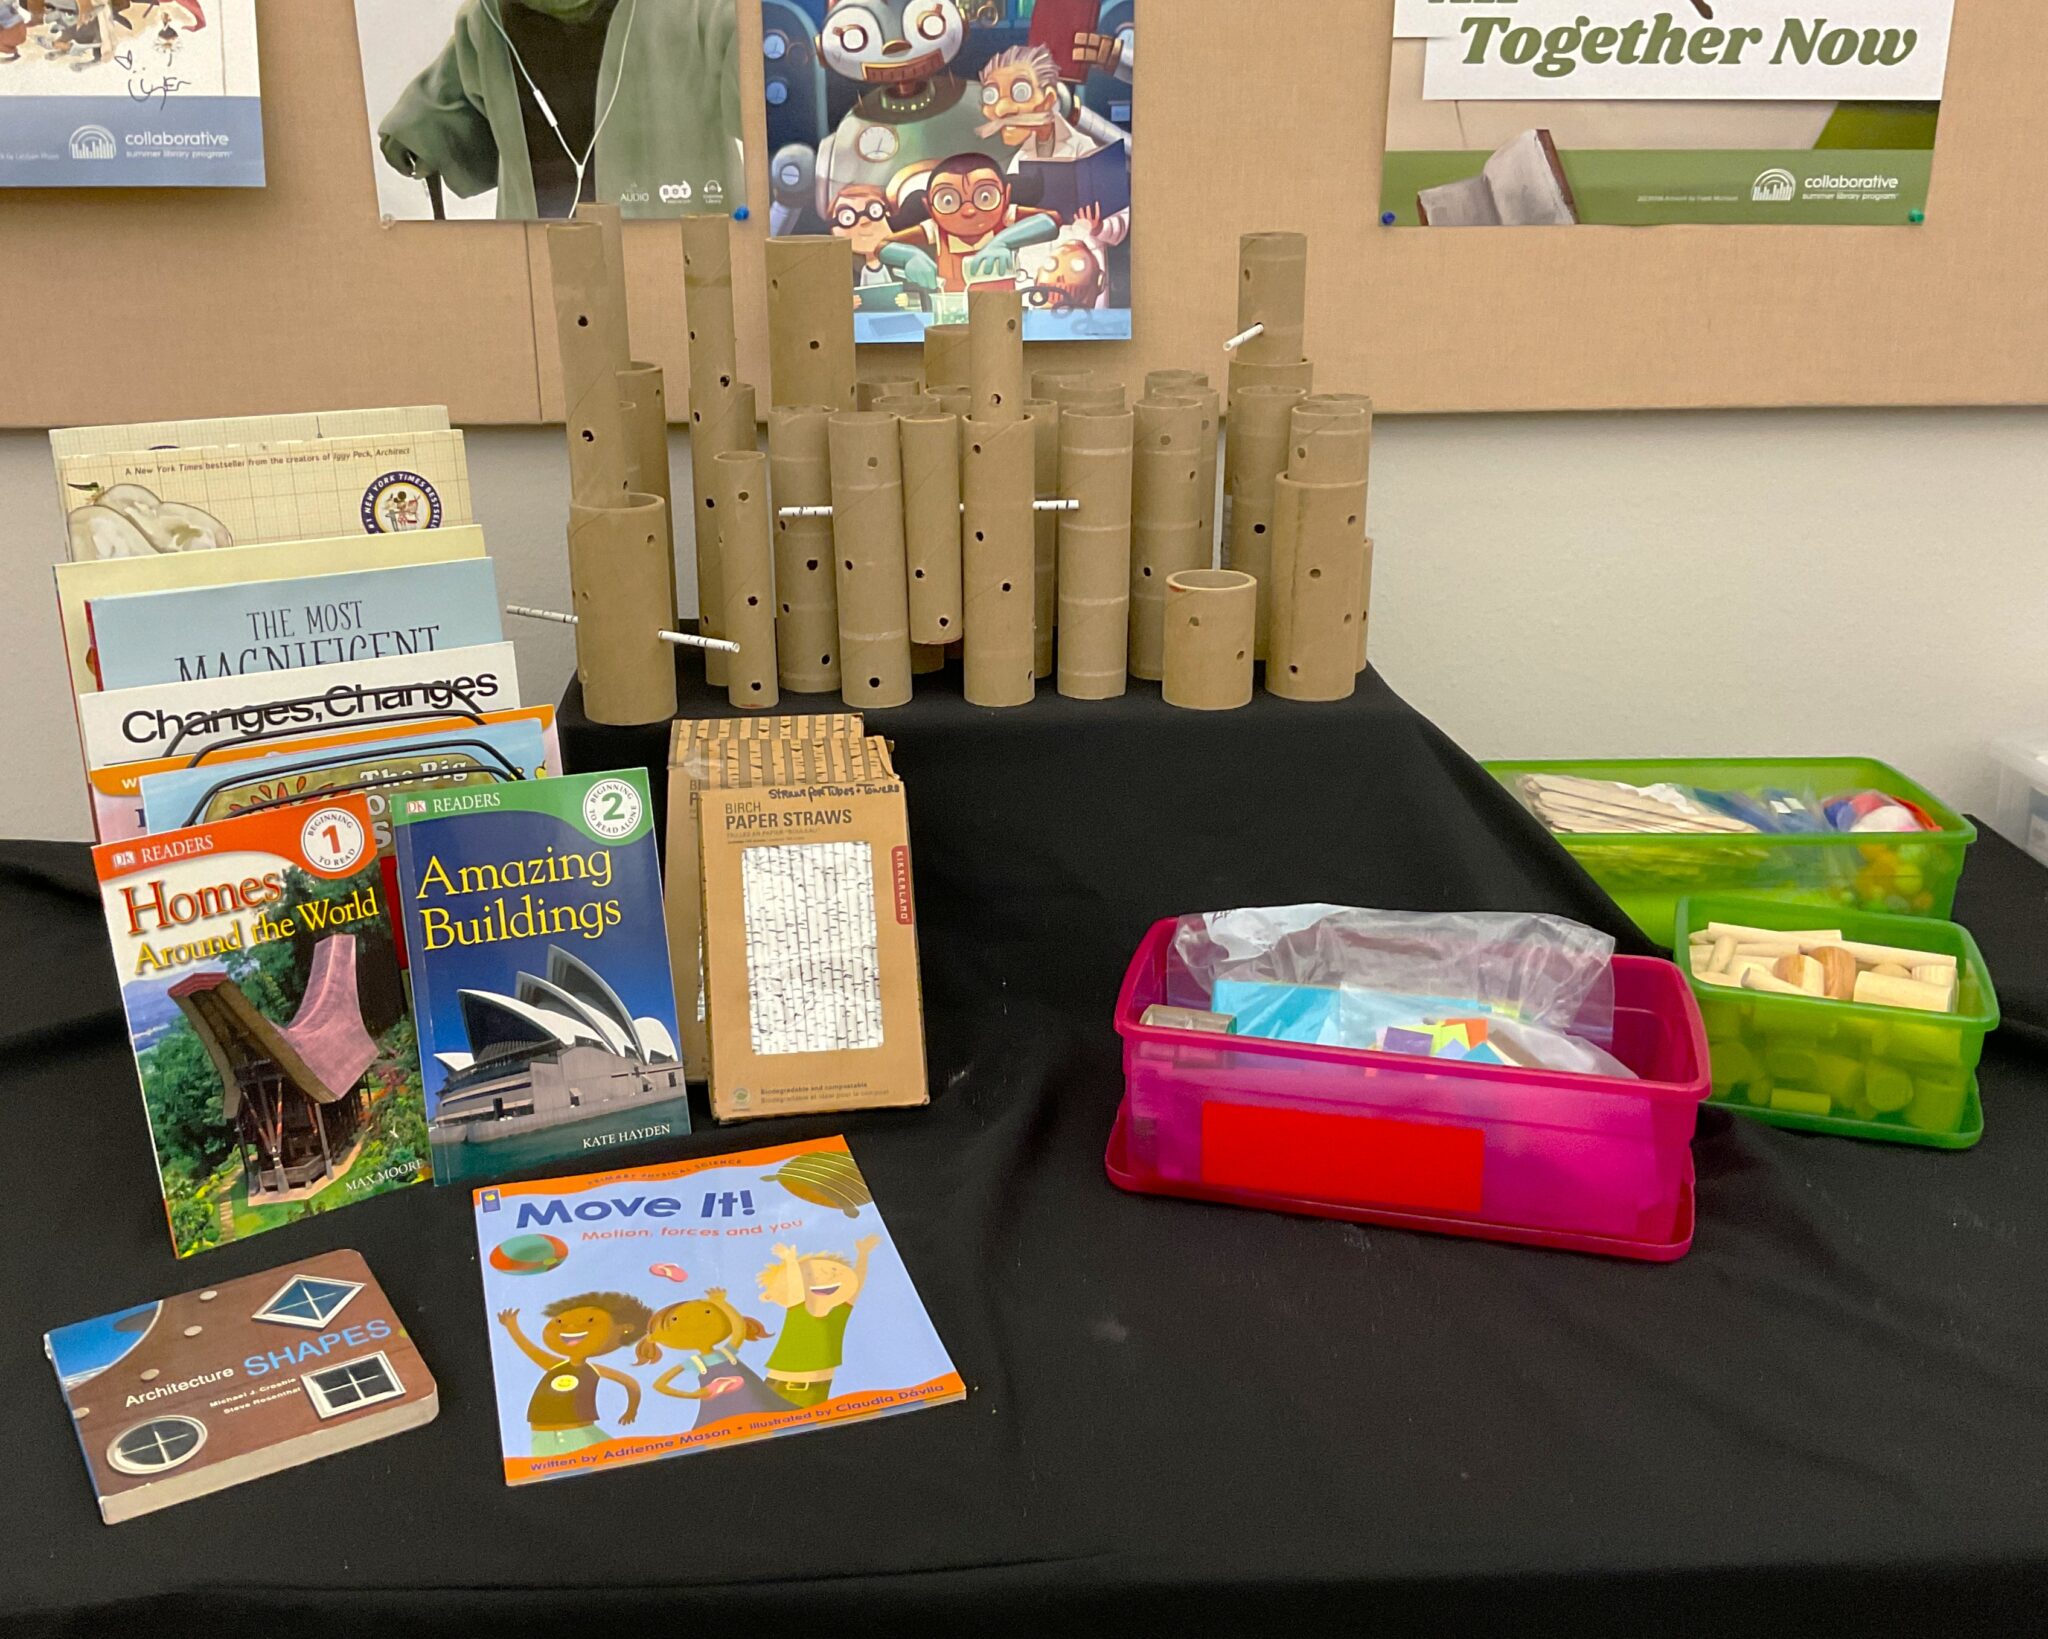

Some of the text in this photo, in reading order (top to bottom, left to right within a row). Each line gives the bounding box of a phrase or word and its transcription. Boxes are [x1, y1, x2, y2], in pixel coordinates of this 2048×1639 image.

[1460, 12, 1918, 79] Together Now
[125, 131, 229, 146] collaborative
[126, 149, 231, 159] summer library program
[1804, 174, 1899, 188] collaborative
[620, 192, 649, 202] AUDIO
[1836, 192, 1860, 201] library
[1862, 193, 1897, 202] program
[125, 467, 132, 476] A
[134, 467, 153, 475] New
[157, 465, 176, 473] York
[179, 463, 203, 471] Times
[205, 460, 246, 470] bestseller
[248, 458, 268, 466] from
[286, 455, 320, 463] creators
[333, 452, 350, 462] Iggy
[375, 447, 410, 457] Architect
[364, 493, 374, 514] NEW
[372, 475, 395, 492] YORK
[398, 473, 426, 487] TIMES
[246, 600, 363, 641] THE MOST
[323, 673, 498, 717] Changes
[360, 760, 468, 790] The Big
[433, 793, 501, 813] READERS
[590, 784, 633, 803] BEGINNING
[602, 792, 625, 821] 2
[725, 802, 761, 814] BIRCH
[307, 813, 354, 836] BEGINNING
[589, 805, 637, 834] TO READ ALONE
[726, 809, 852, 830] PAPER STRAWS
[142, 835, 214, 864] READERS
[322, 824, 341, 854] 1
[319, 848, 356, 866] TO READ
[416, 846, 612, 899] Amazing
[895, 851, 908, 920] KIKKERLAND
[119, 871, 284, 935] Homes
[135, 886, 380, 975] Around the World
[419, 894, 622, 950] Buildings
[582, 1124, 671, 1149] KATE HAYDEN
[346, 1159, 423, 1193] MAX MOORE
[587, 1159, 742, 1185] PRIMARY PHYSICAL SCIENCE
[516, 1189, 756, 1229] Move It!
[582, 1220, 803, 1241] Motion, forces and you
[125, 1319, 392, 1408] Architecture SHAPES
[209, 1391, 248, 1408] Michael
[259, 1378, 296, 1392] Crosbie
[223, 1386, 301, 1414] Steve Rosenthal
[530, 1458, 577, 1472] Written
[581, 1453, 598, 1464] by
[603, 1439, 674, 1459] Adrienne
[679, 1428, 731, 1445] Mason
[816, 1407, 832, 1418] by
[836, 1394, 895, 1412] Claudia
[898, 1383, 944, 1400] Dávila
